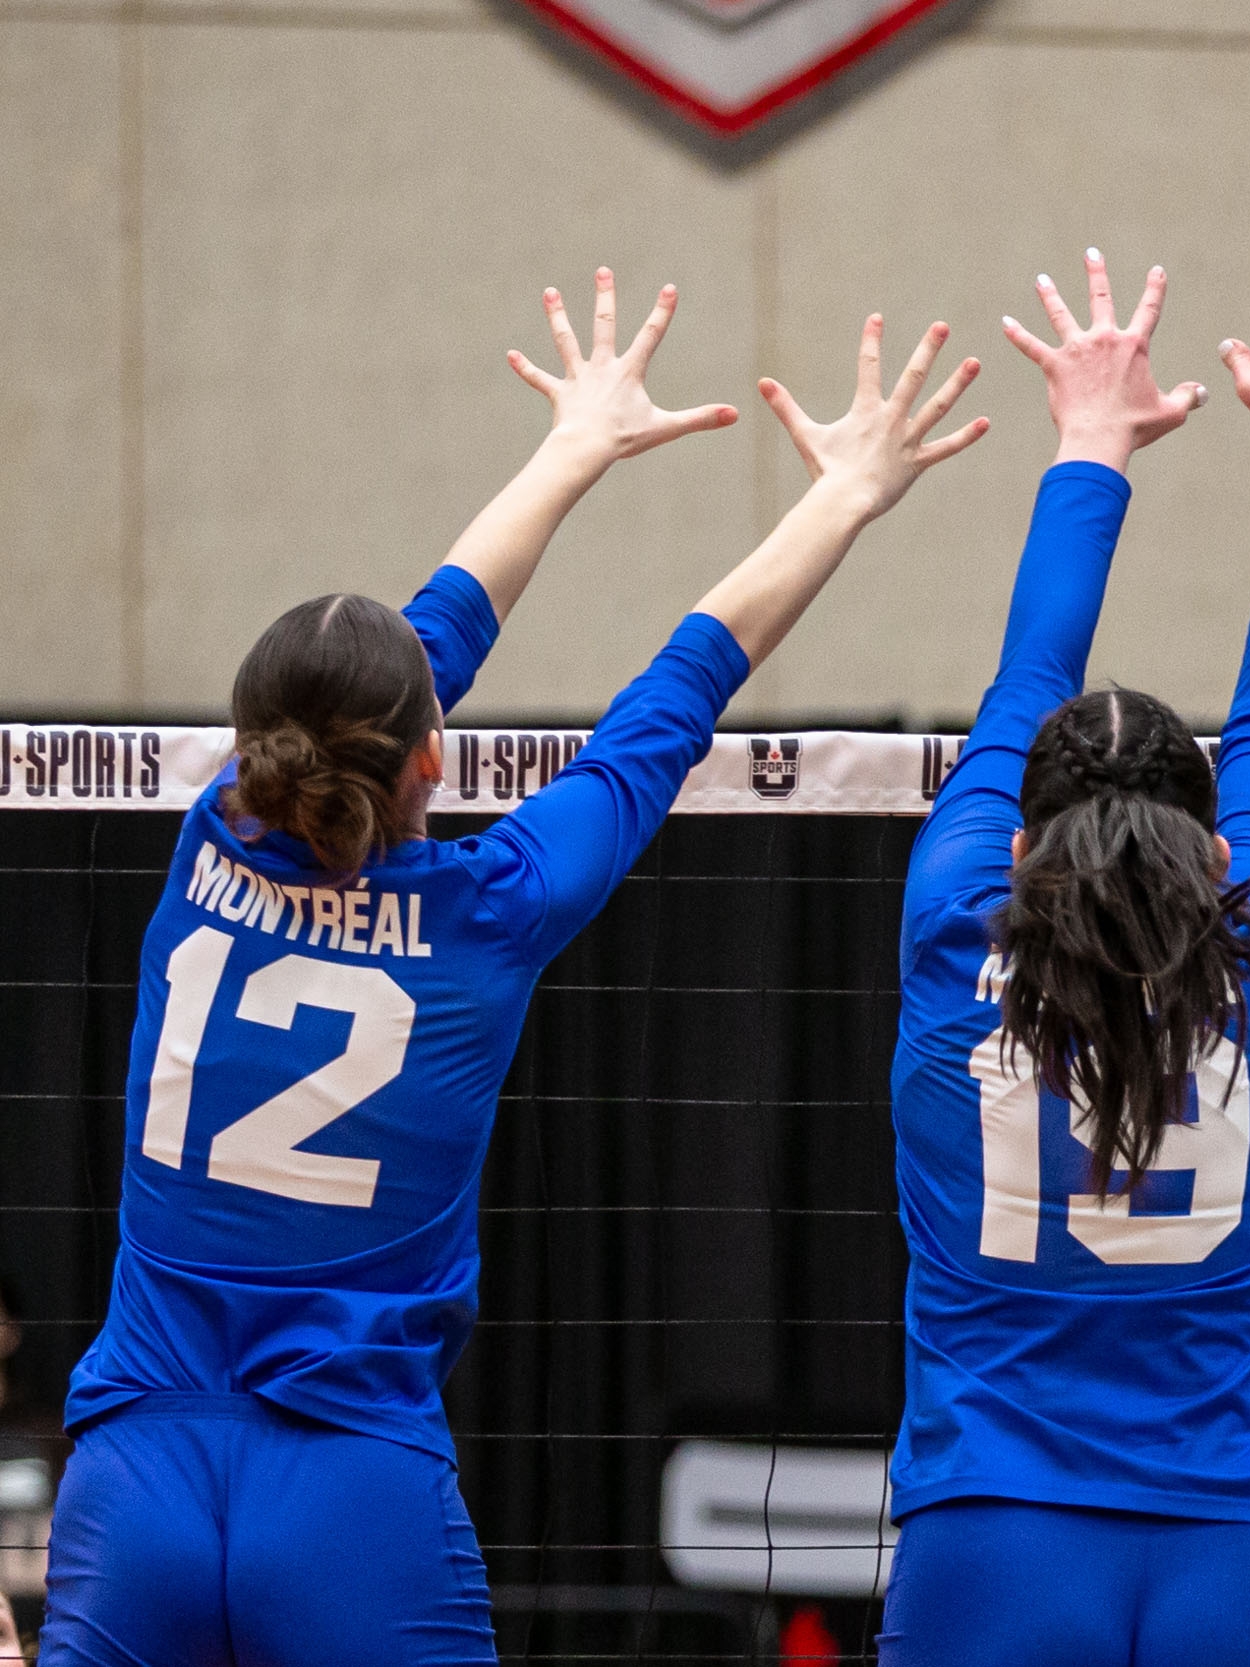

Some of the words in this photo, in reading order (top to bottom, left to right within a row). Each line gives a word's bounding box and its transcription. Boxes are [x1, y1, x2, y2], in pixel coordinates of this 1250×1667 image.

[26, 730, 161, 798] SPORTS
[752, 761, 797, 774] SPORTS
[186, 840, 432, 958] MONTRÉAL
[142, 924, 417, 1208] 12
